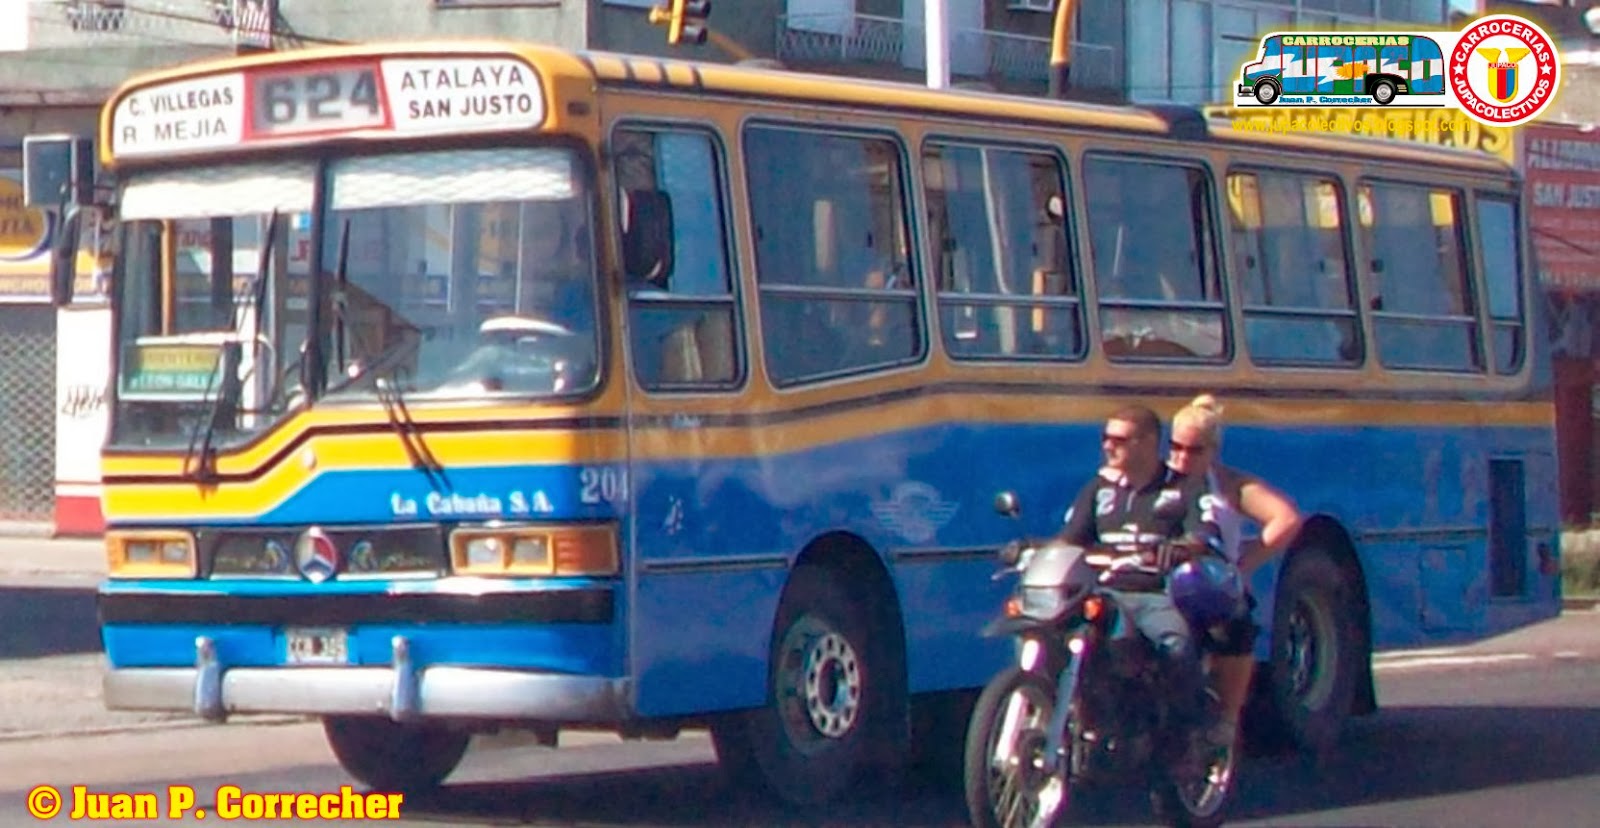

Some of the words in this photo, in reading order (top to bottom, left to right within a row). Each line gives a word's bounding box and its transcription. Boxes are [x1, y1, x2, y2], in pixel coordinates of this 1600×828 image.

[401, 65, 525, 92] ATALAYA
[150, 86, 234, 114] VILLEGAS
[265, 75, 379, 124] 624
[408, 100, 451, 120] SAN
[460, 93, 533, 117] JUSTO
[154, 116, 228, 141] MEJIA
[391, 492, 418, 515] La
